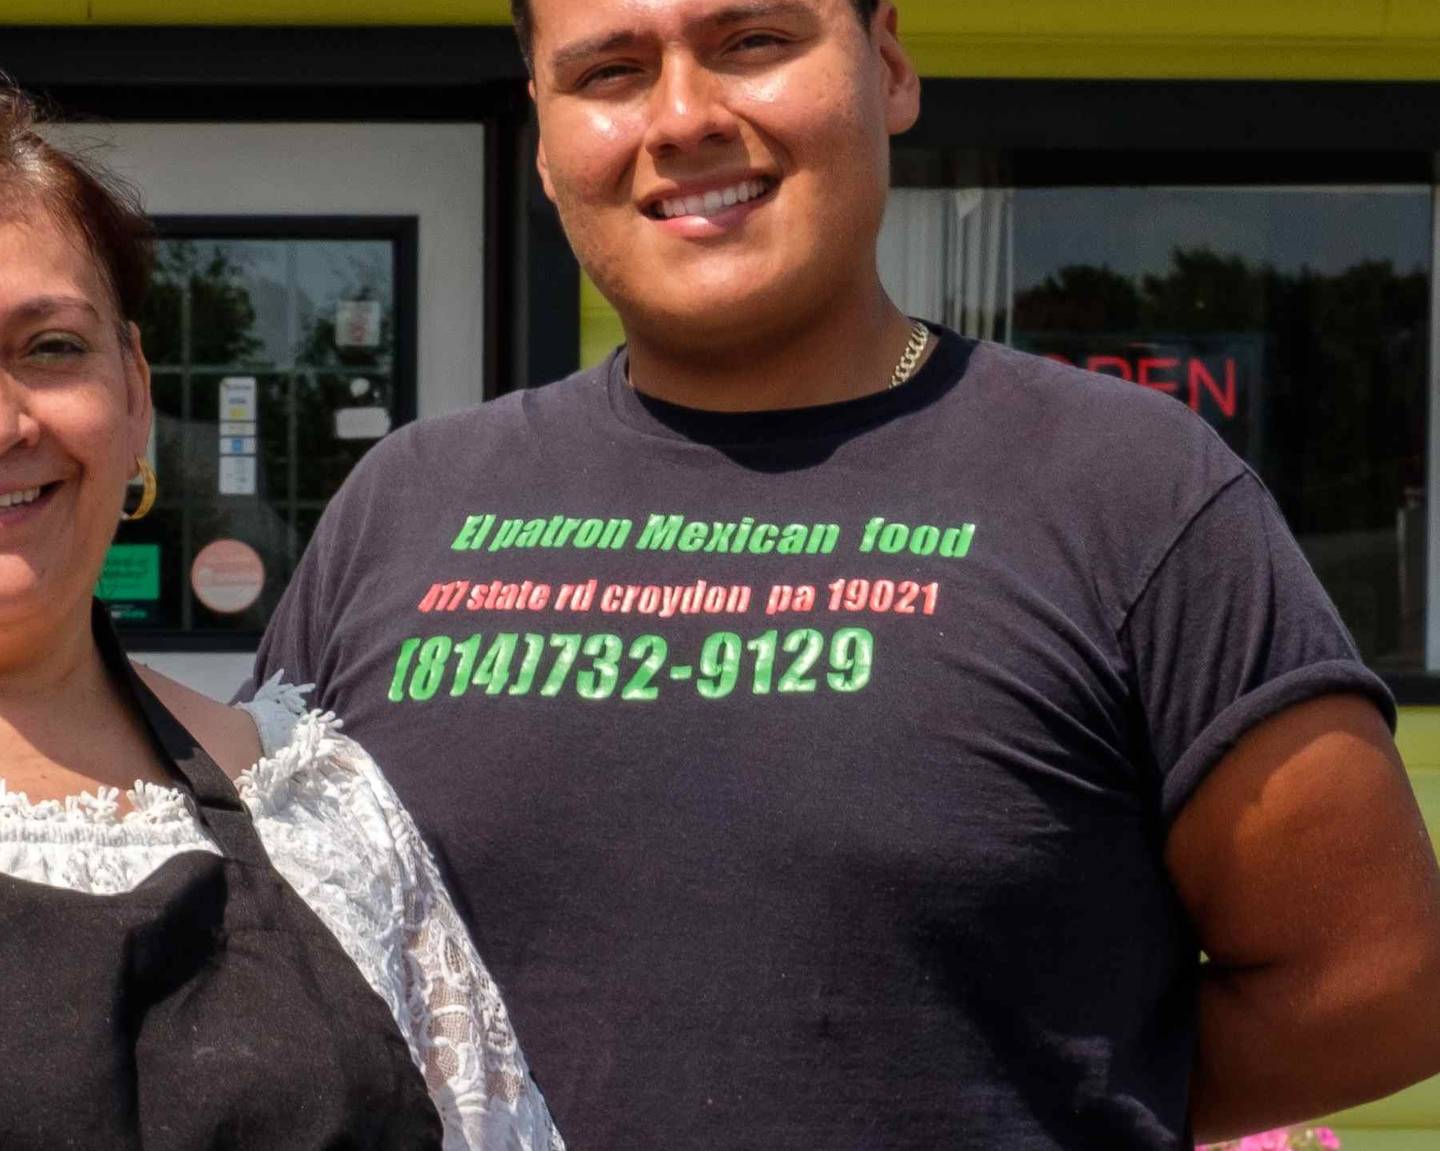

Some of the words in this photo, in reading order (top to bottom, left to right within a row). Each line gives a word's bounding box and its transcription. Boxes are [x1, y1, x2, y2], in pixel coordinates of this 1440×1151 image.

[450, 514, 497, 551] El
[486, 515, 634, 552] patron
[636, 514, 841, 555] Mexican
[859, 517, 976, 558] food
[466, 579, 552, 612] state
[555, 578, 600, 614] rd
[600, 580, 751, 618] croydon
[765, 585, 816, 616] pa
[827, 578, 939, 616] 19021
